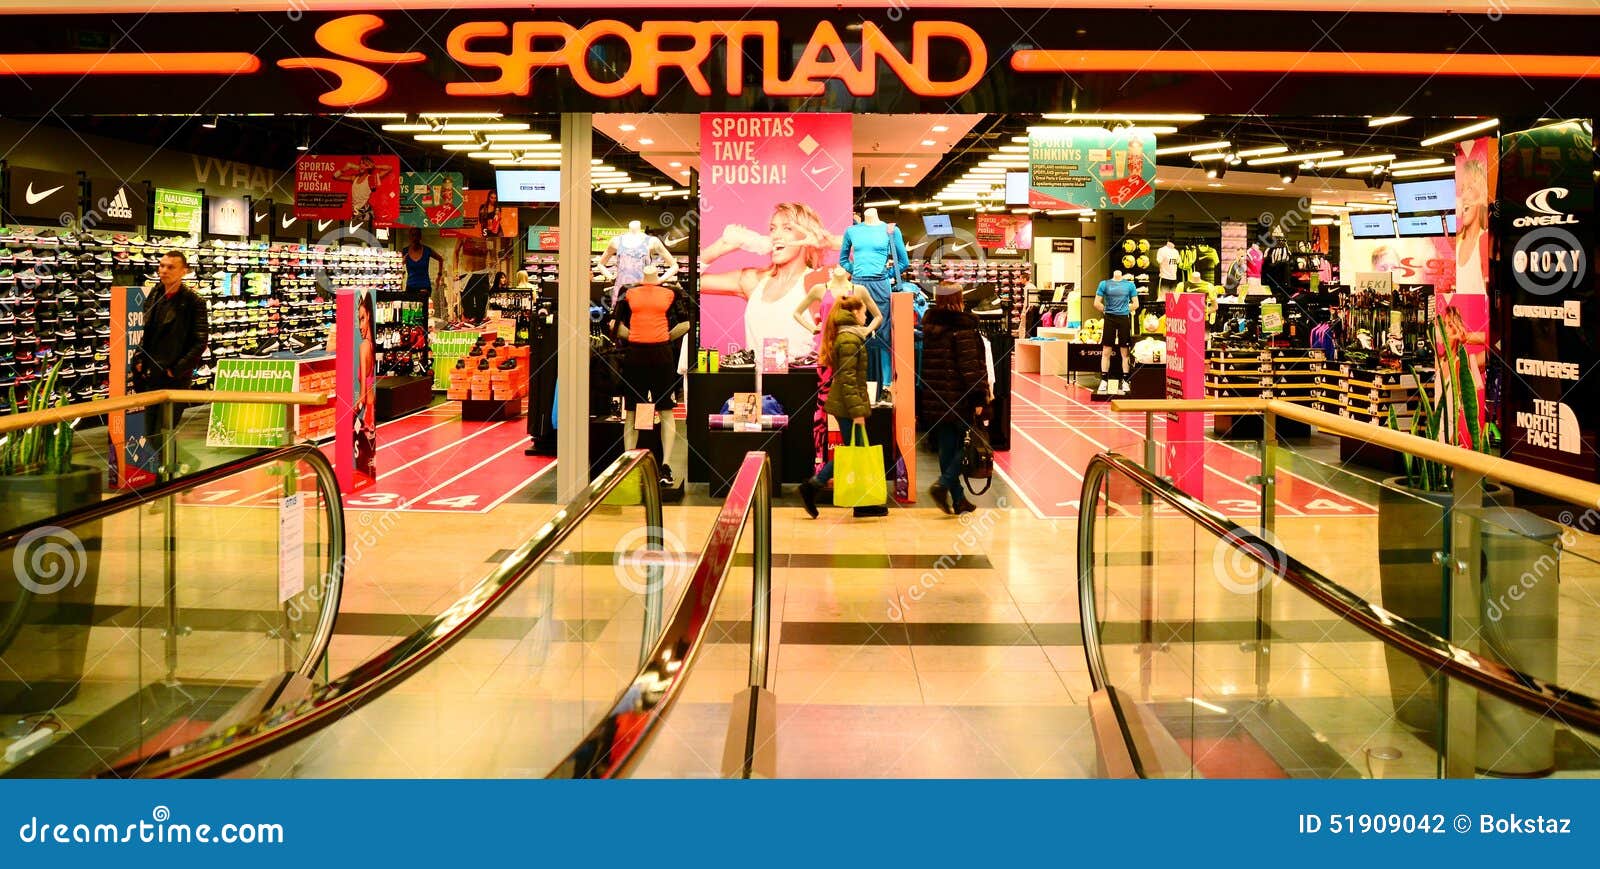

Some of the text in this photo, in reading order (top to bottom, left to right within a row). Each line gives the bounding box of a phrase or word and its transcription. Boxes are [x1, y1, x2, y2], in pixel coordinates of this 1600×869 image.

[446, 20, 988, 97] SPORTLAND
[711, 117, 794, 138] SPORTAS
[1032, 148, 1082, 161] RINKINYS
[299, 162, 336, 172] SPORTAS
[711, 160, 787, 185] PUOŠIA!
[107, 207, 132, 219] adidas
[1530, 250, 1580, 272] ROXY
[219, 368, 292, 380] NAUJIENA
[1516, 358, 1580, 381] CONVERSE
[1533, 398, 1558, 417] THE
[1516, 411, 1558, 434] NORTH
[1527, 429, 1558, 450] FACE
[427, 494, 481, 508] 4
[1305, 499, 1356, 512] 4
